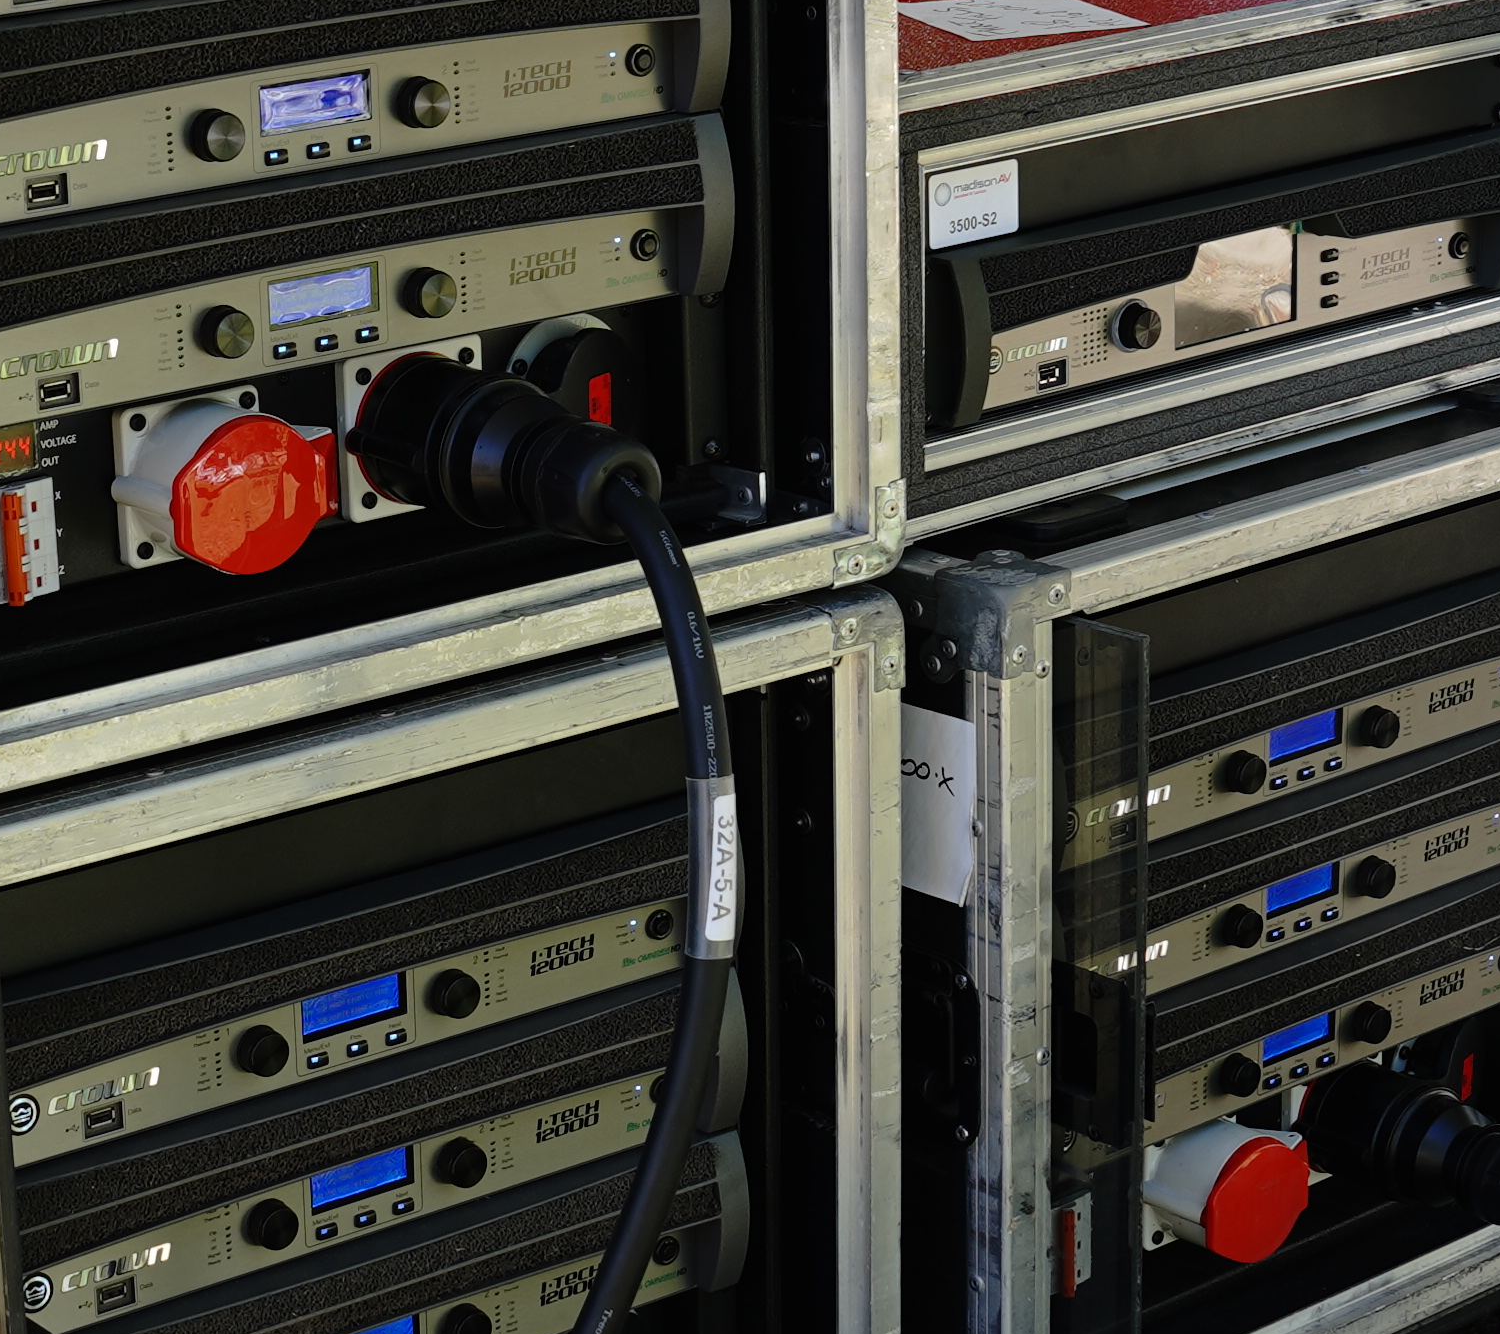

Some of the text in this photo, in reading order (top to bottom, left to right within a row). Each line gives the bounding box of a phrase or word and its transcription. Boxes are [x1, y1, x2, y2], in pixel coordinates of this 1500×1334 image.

[502, 75, 571, 98] 12000
[953, 172, 1012, 194] madisonAV
[949, 211, 998, 234] 3500-S2
[509, 262, 576, 285] 12000
[0, 338, 120, 379] crown
[1006, 336, 1067, 362] crown
[40, 419, 60, 431] AMP
[40, 434, 77, 449] VOLTAGE
[41, 456, 60, 467] OUT
[55, 491, 62, 501] X
[57, 529, 64, 538] Y
[59, 565, 65, 575] Z
[1428, 689, 1474, 714] 12000
[1424, 836, 1469, 862] 12000
[711, 815, 735, 921] 32A-5-A
[530, 947, 594, 977] 12000
[1419, 979, 1465, 1006] 12000
[47, 1066, 160, 1116] crown
[536, 1113, 599, 1143] 12000
[61, 1243, 171, 1293] crown
